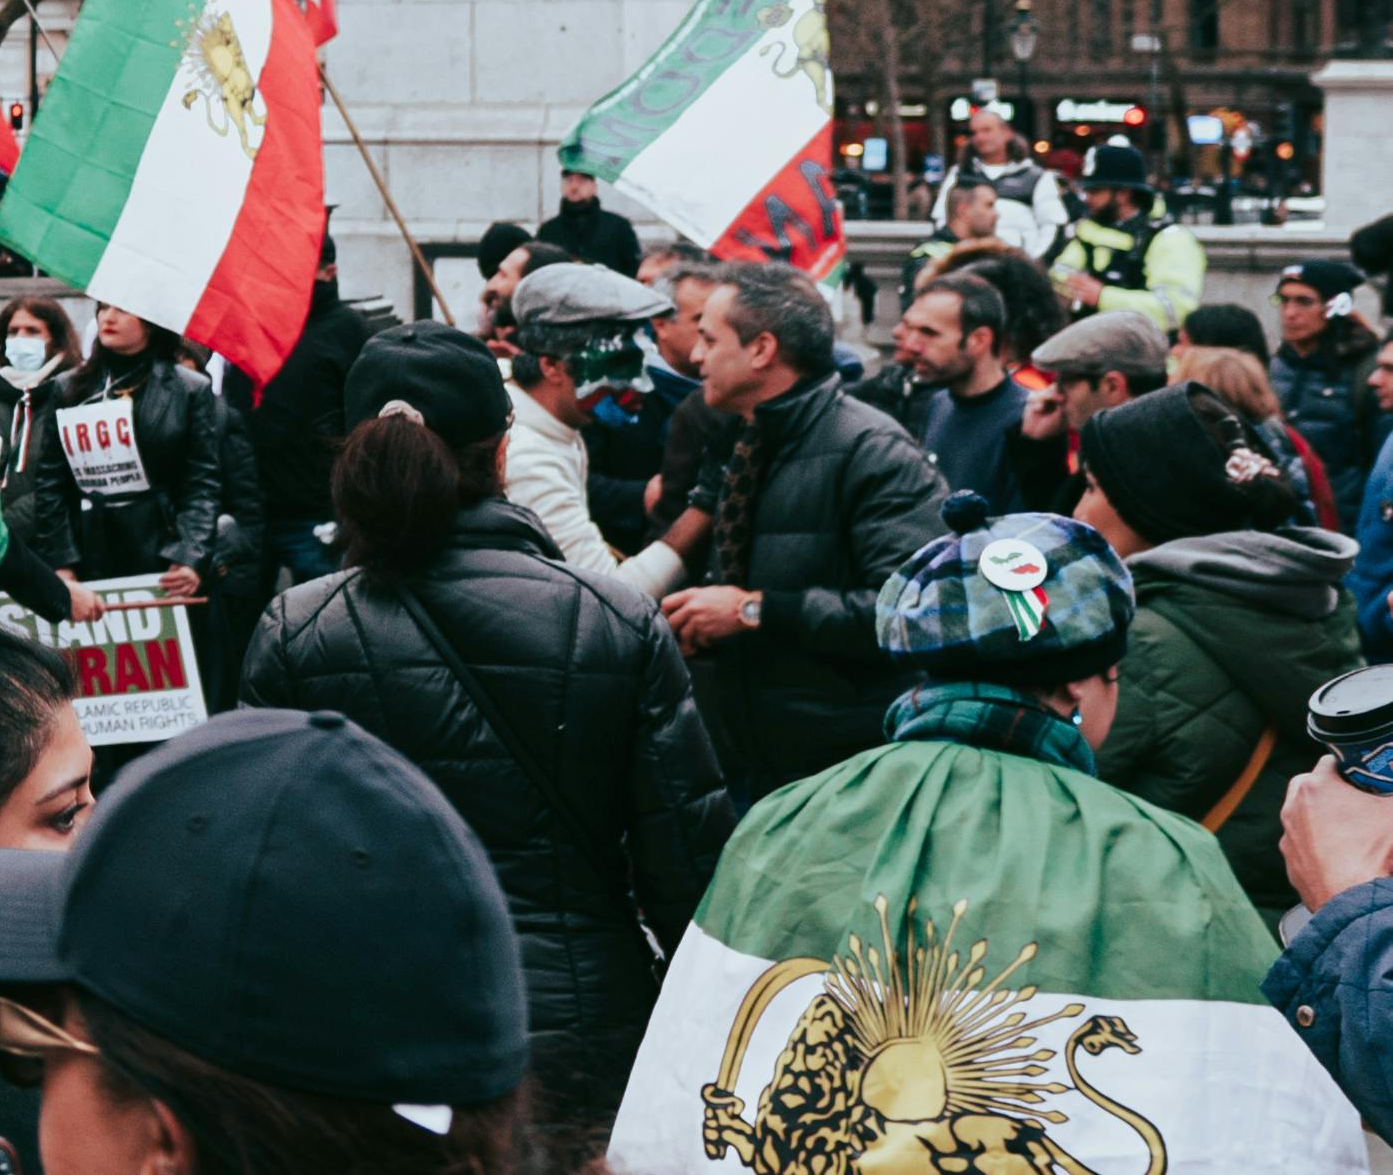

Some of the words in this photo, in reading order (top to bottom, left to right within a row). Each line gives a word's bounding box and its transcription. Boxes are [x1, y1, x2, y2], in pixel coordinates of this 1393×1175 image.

[63, 417, 131, 457] IRGC
[71, 638, 189, 698] RAN
[78, 701, 121, 719] LAMIC
[124, 695, 192, 716] REPUBLIC
[82, 716, 135, 735] HUMAN
[139, 711, 199, 730] RIGHTS
